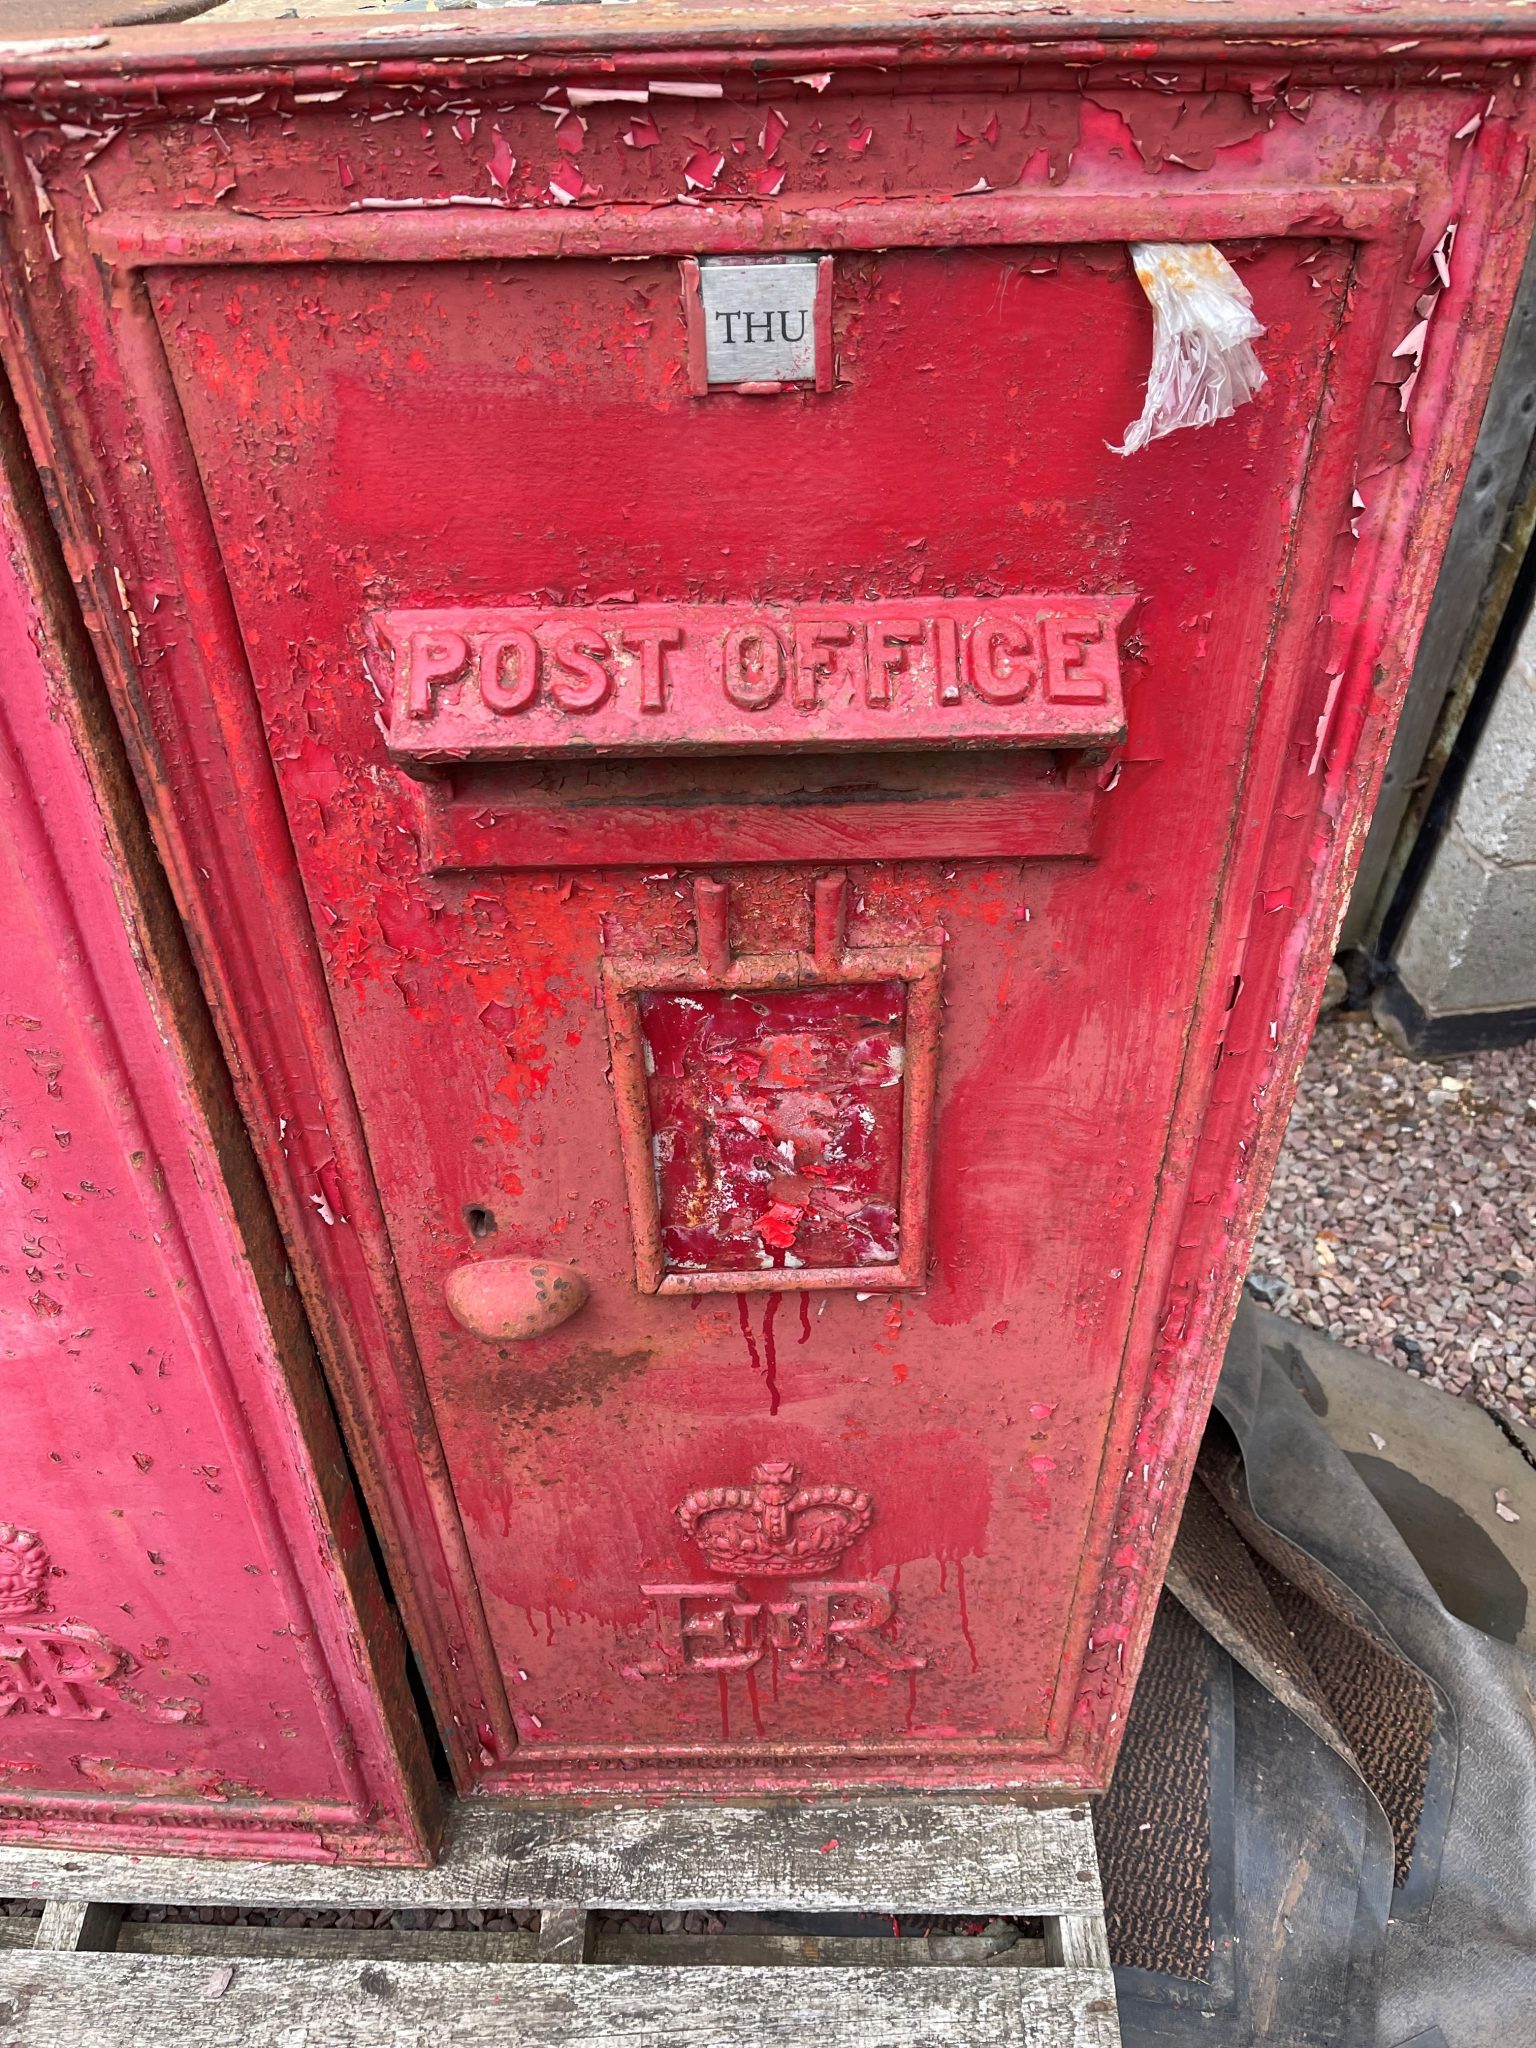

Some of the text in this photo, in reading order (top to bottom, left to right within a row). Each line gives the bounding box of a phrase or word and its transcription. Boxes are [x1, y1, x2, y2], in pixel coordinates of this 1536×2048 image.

[714, 309, 809, 345] THU
[406, 618, 1110, 722] POST OFFICE
